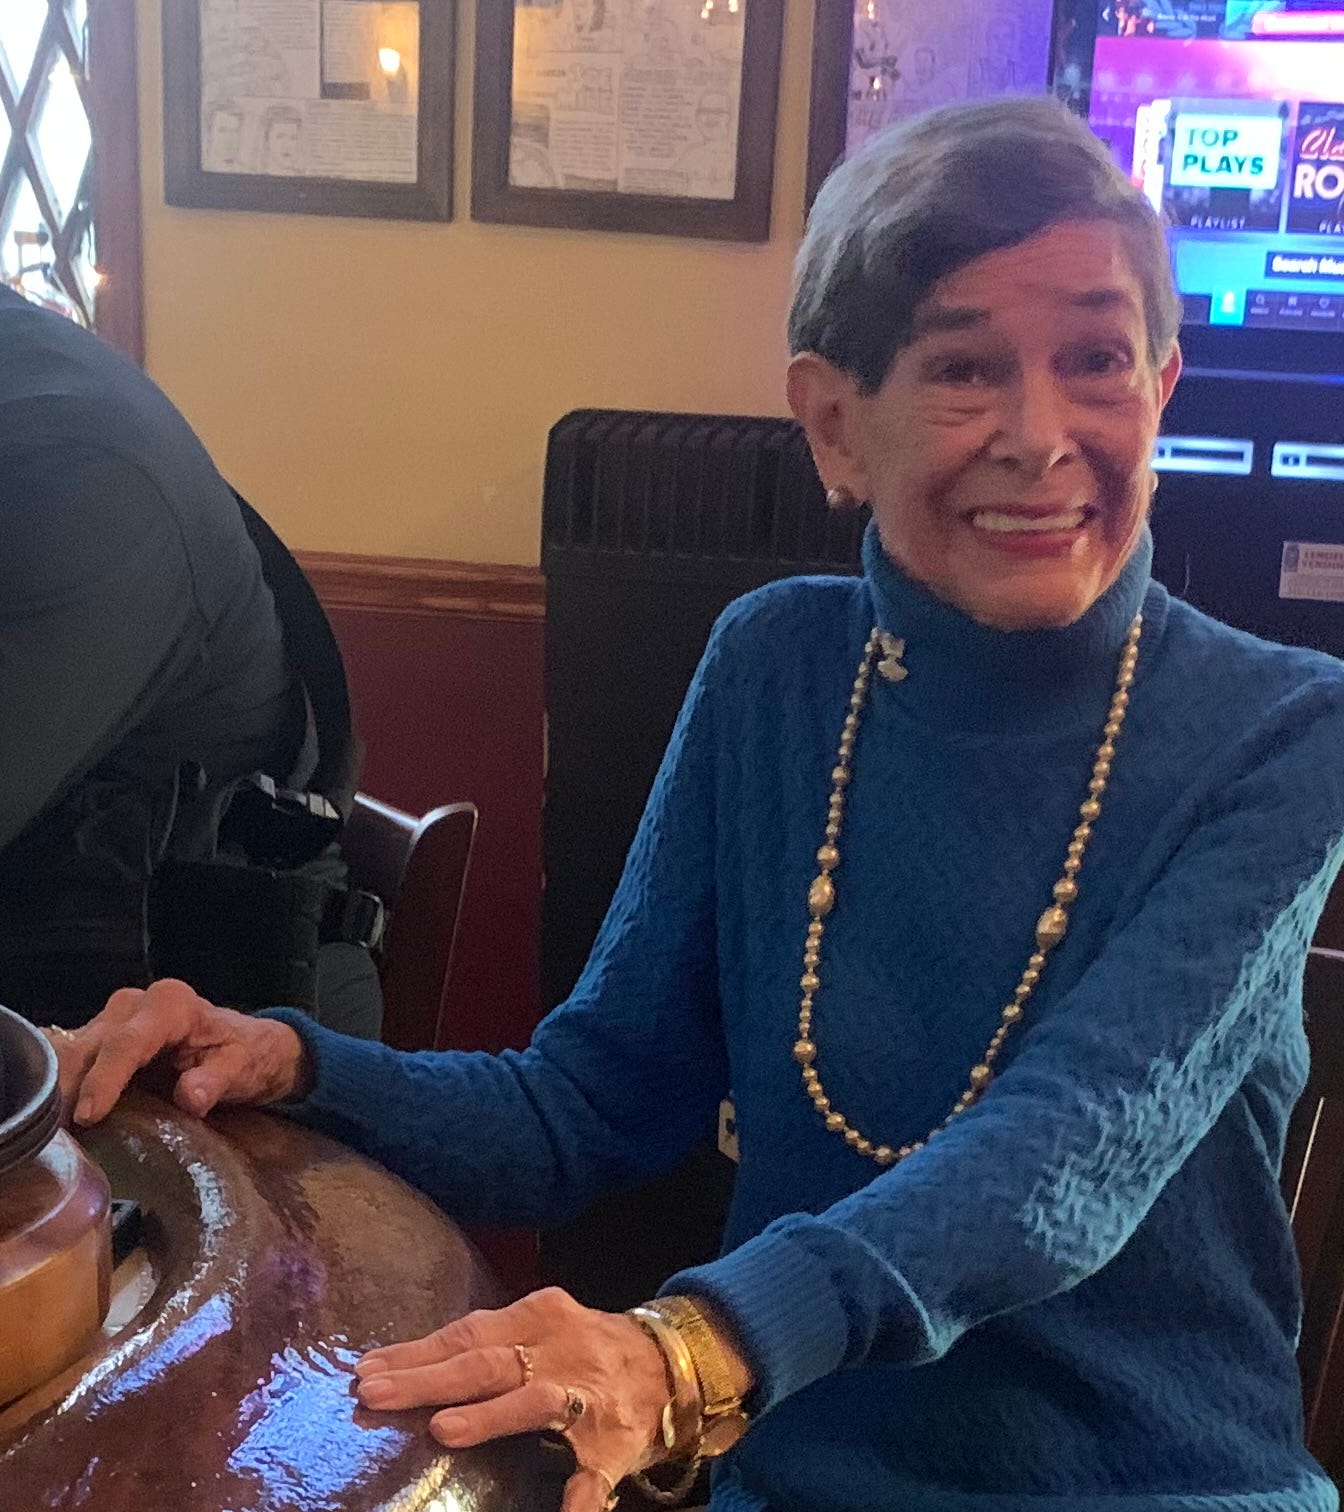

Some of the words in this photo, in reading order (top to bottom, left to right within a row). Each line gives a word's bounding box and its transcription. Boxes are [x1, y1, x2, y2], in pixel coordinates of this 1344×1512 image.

[1186, 128, 1239, 147] TOP
[1182, 153, 1264, 175] PLAYS
[1190, 215, 1246, 229] PLAYLIST
